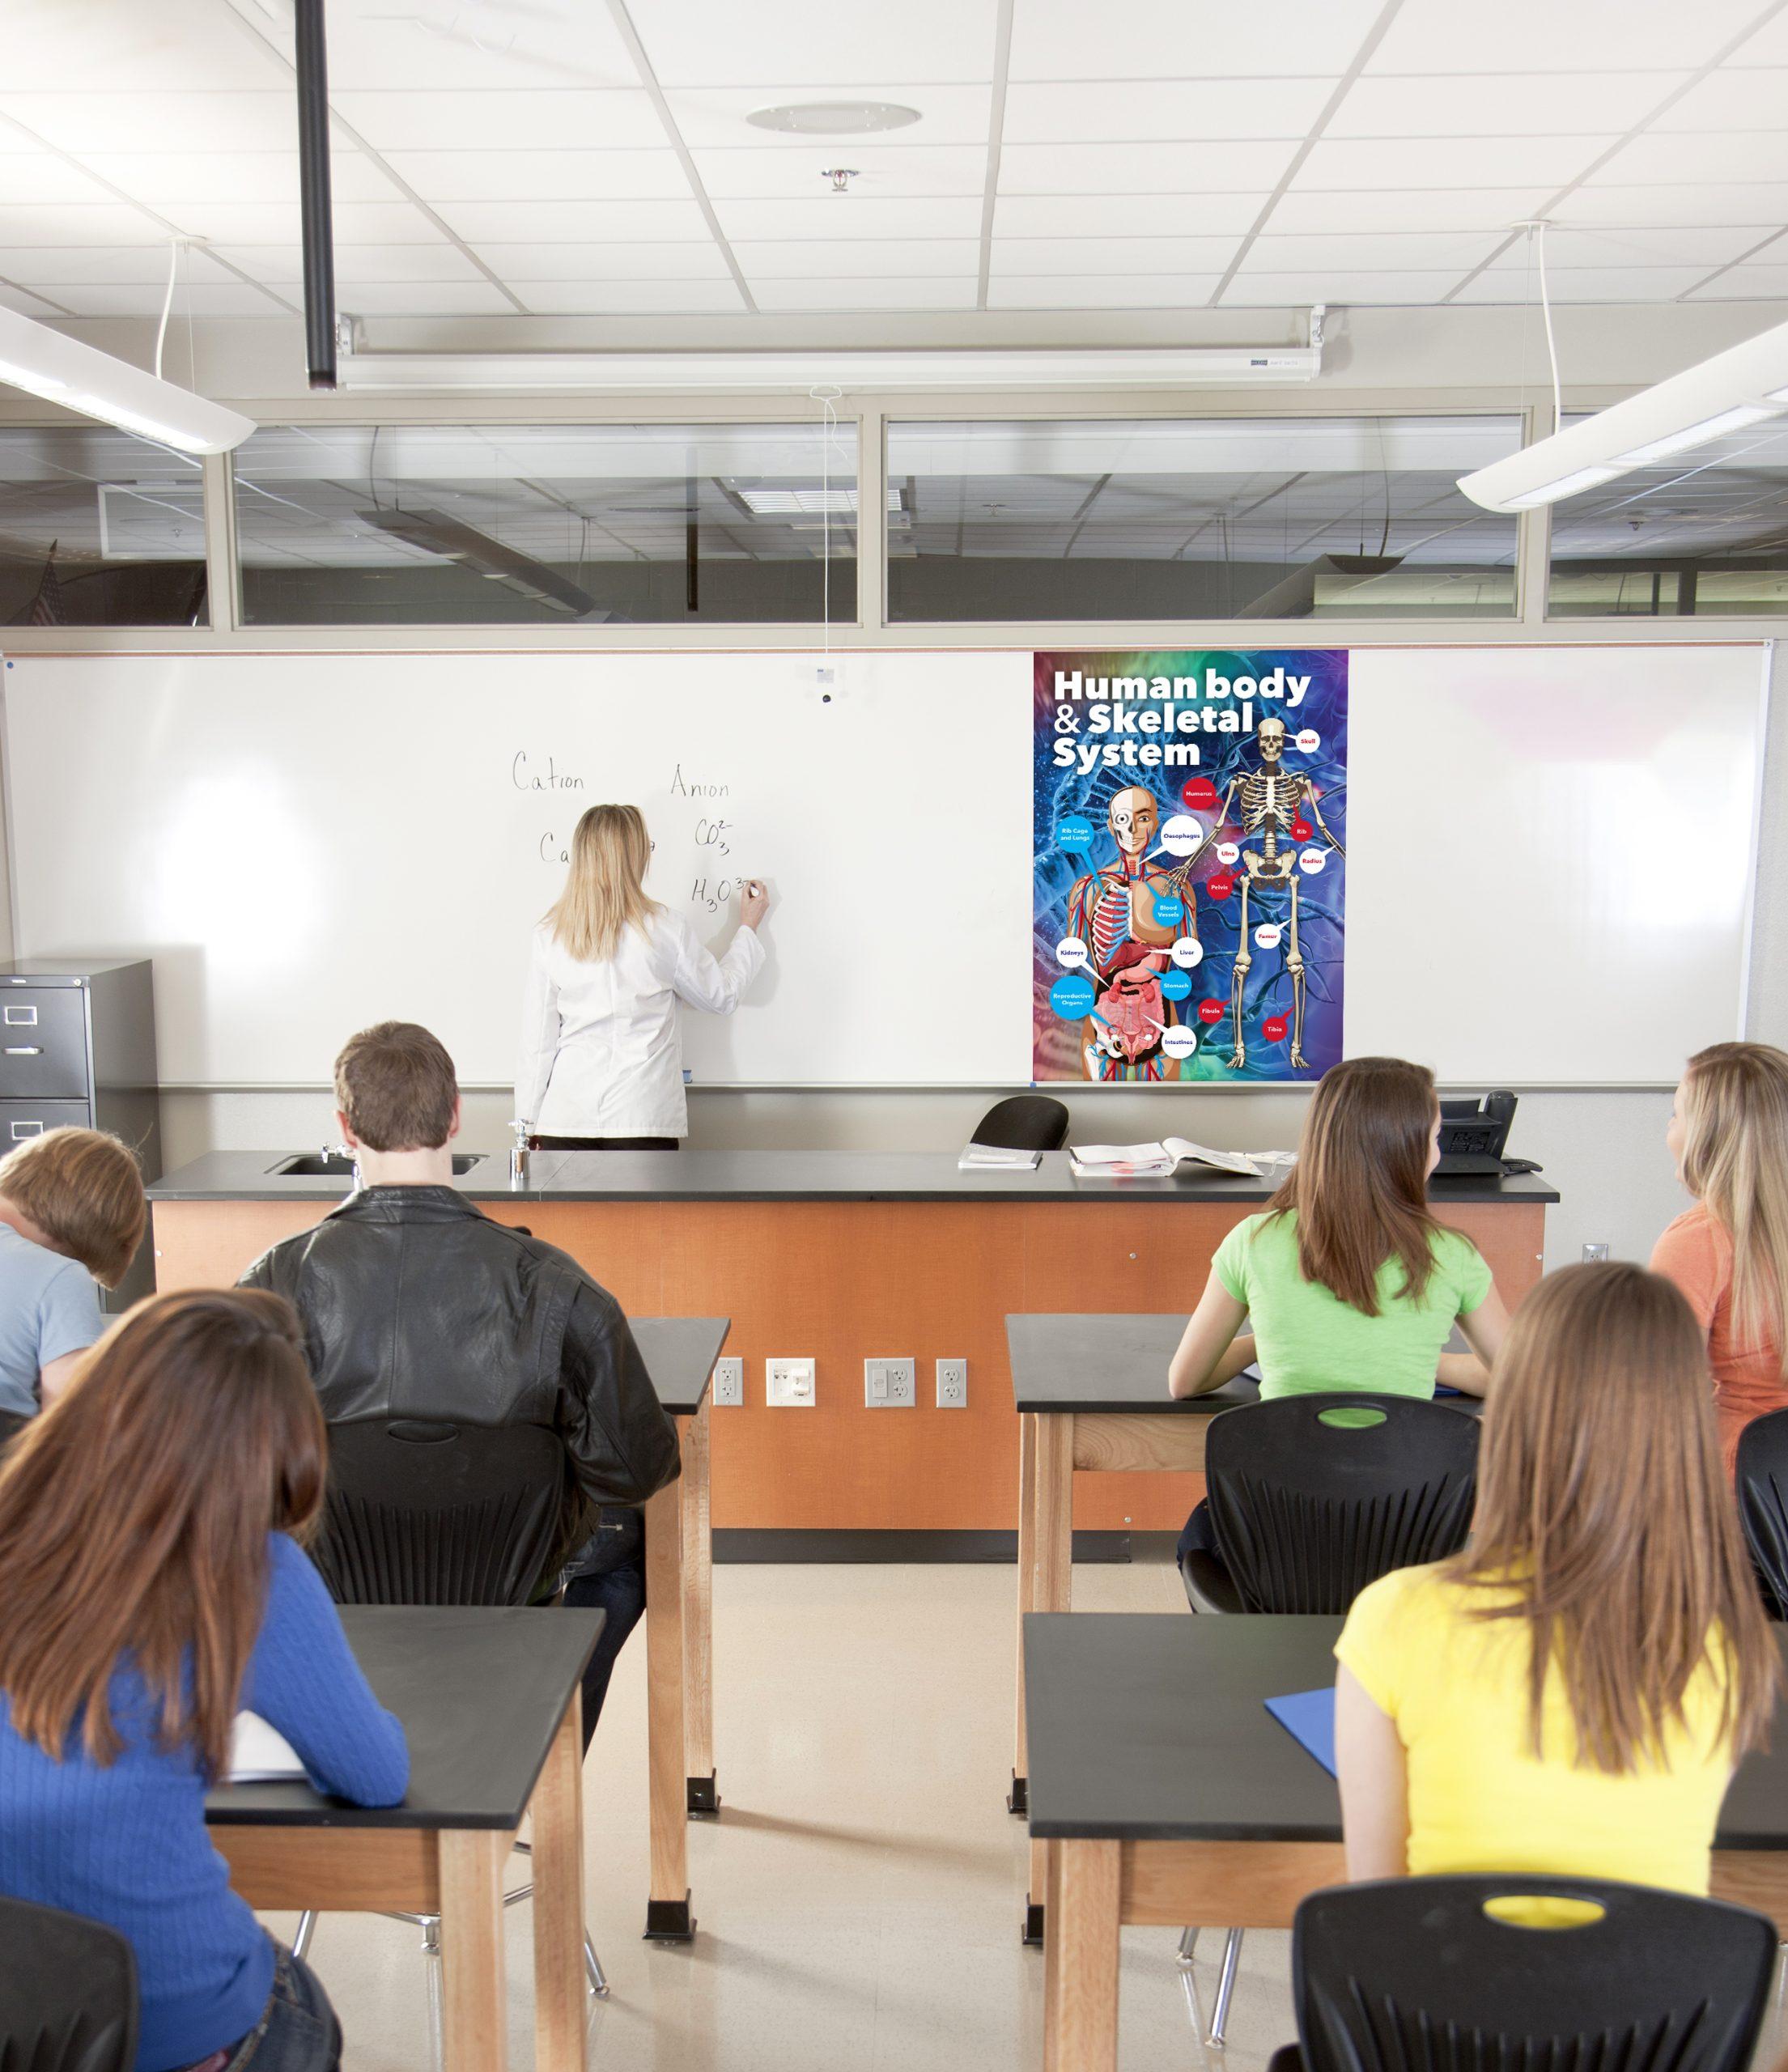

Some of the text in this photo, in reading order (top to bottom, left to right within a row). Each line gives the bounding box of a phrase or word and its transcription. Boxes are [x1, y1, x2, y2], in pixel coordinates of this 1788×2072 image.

[1055, 668, 1311, 707] Human body
[1054, 702, 1253, 734] & Skeletal
[512, 750, 584, 791] Cation
[1052, 737, 1200, 775] System
[670, 764, 729, 797] Anion
